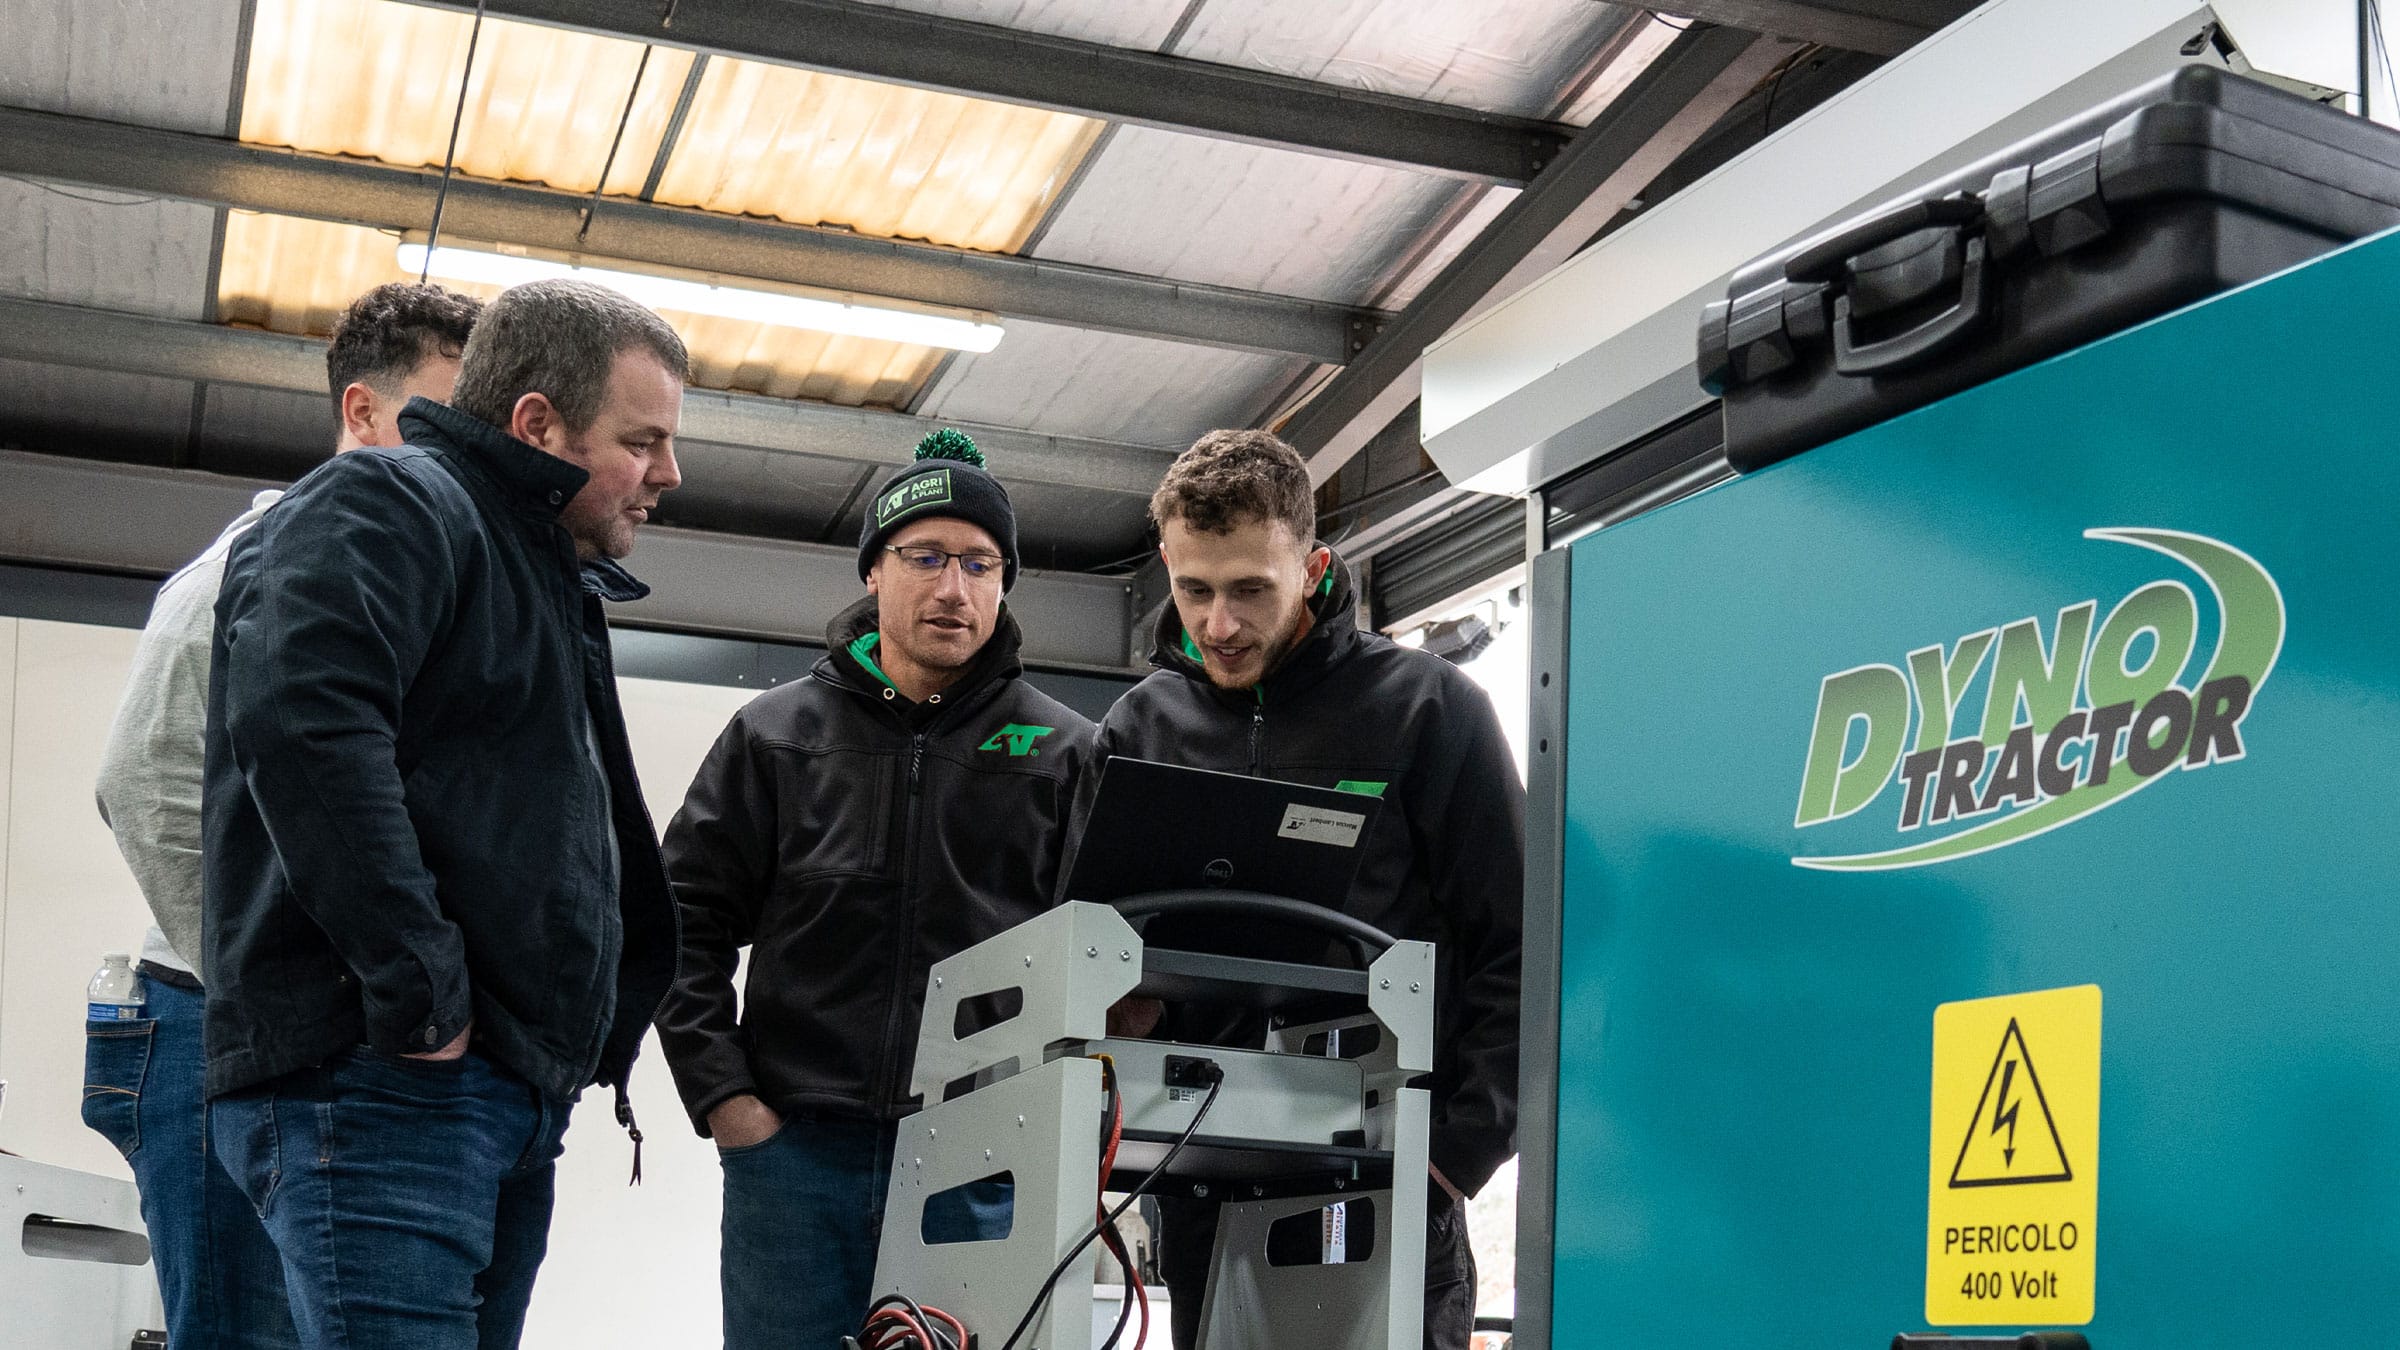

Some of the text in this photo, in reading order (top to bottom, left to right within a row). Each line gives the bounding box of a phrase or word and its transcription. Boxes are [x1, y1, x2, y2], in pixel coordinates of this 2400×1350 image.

[911, 477, 943, 493] AGRI
[919, 488, 943, 498] PLANT
[882, 486, 910, 518] AT
[1795, 580, 2199, 828] DYNO
[1899, 674, 2251, 831] TRACTOR
[1945, 1222, 2078, 1254] PERICOLO
[1961, 1270, 2058, 1299] 400 Volt
